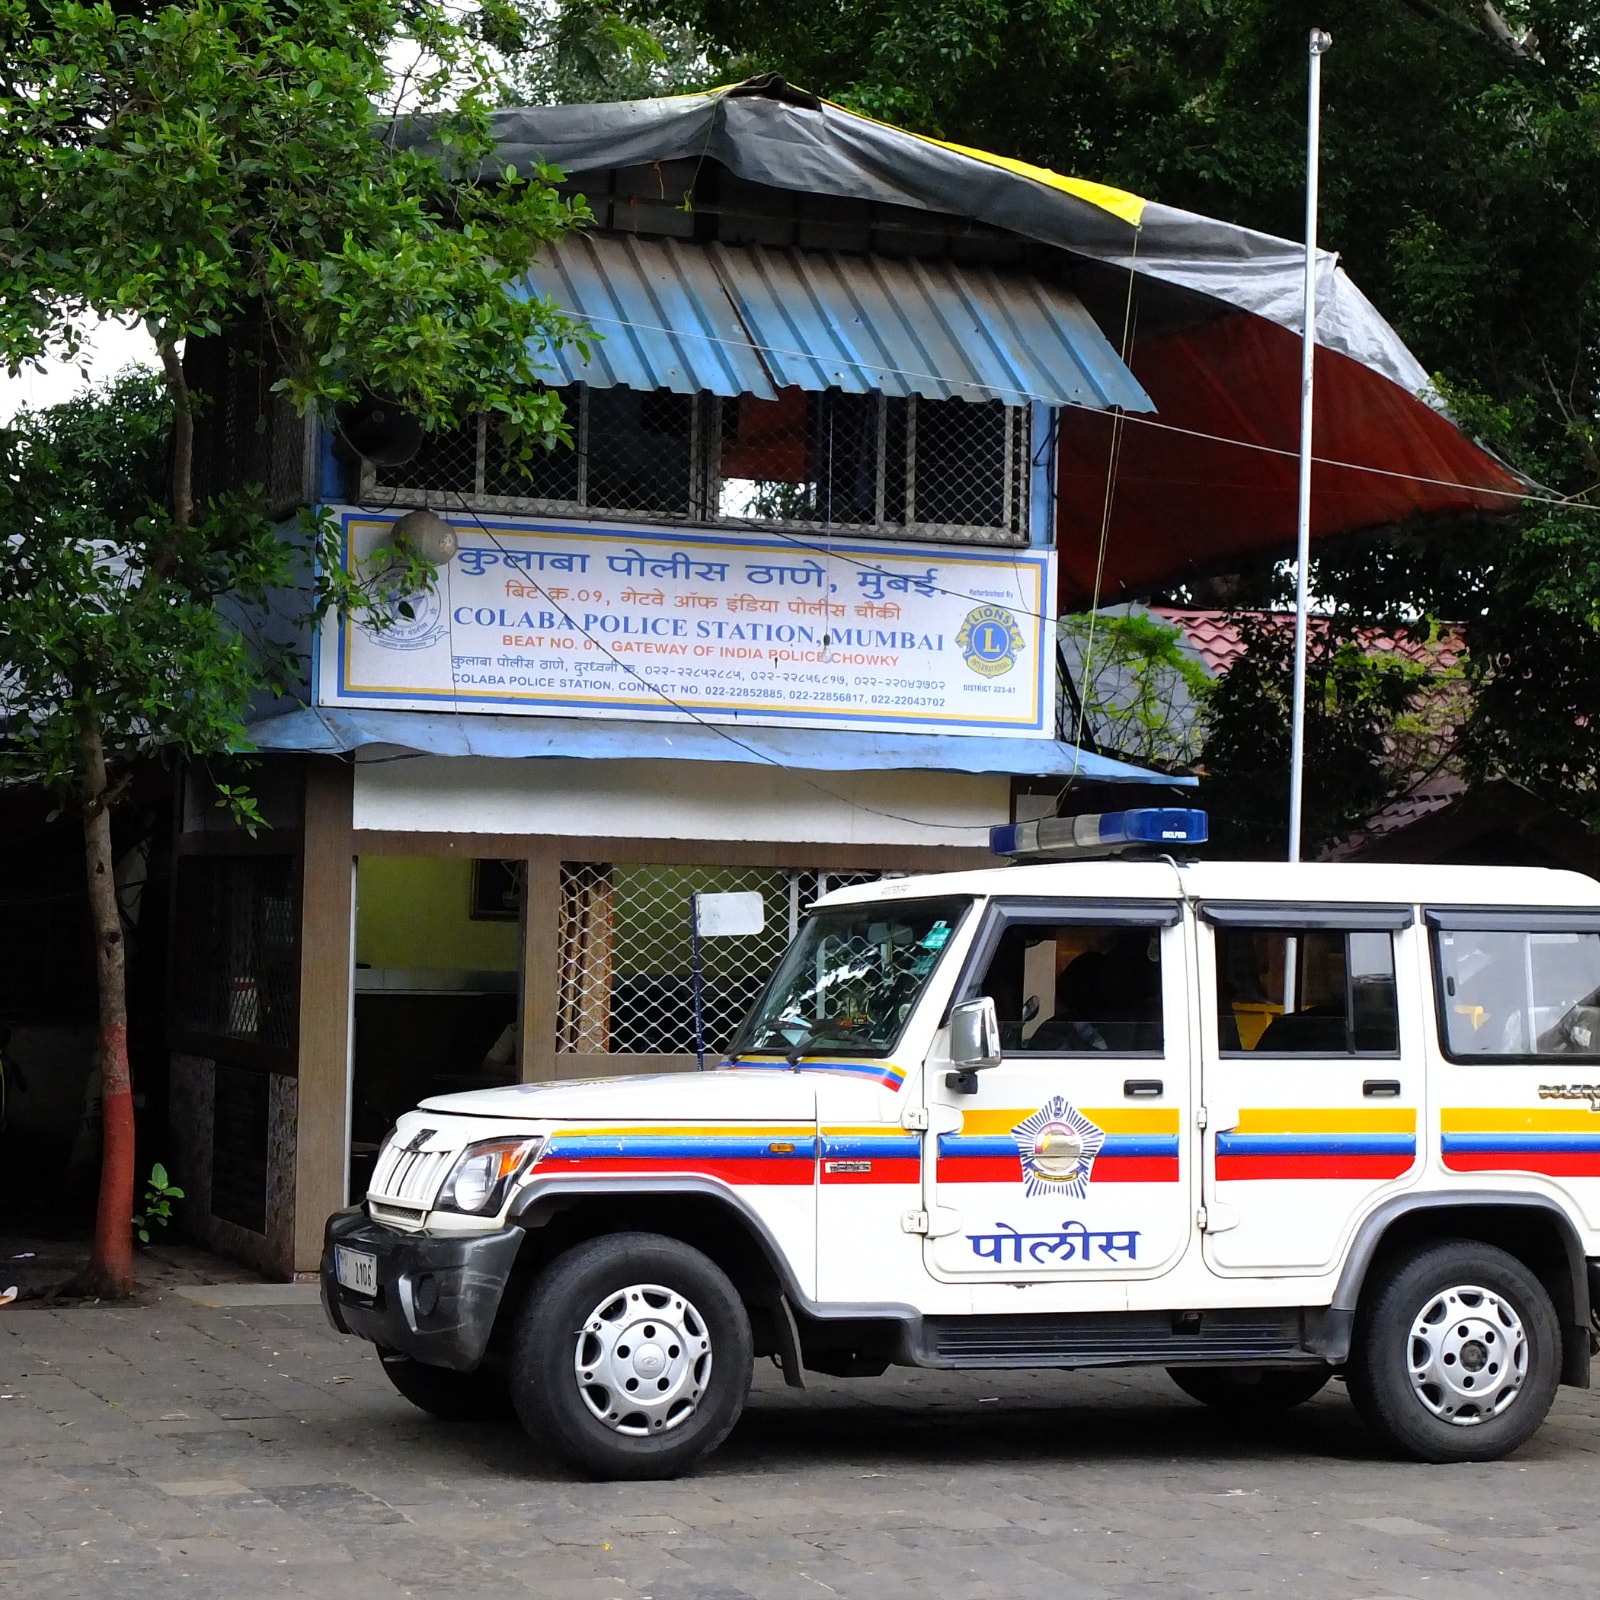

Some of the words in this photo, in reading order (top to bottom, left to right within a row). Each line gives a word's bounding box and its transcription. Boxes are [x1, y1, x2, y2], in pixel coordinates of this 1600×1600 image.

[457, 547, 591, 576] कुलाबा
[606, 548, 730, 582] पोलीस
[745, 559, 838, 593] ठाणे,
[857, 565, 948, 599] मुंबई.
[505, 579, 539, 599] बिट
[620, 586, 665, 606] गेटवे
[673, 592, 719, 609] ऑफ
[726, 593, 779, 613] इंडिया
[788, 596, 846, 617] पोलीस
[854, 601, 901, 620] चौकी
[454, 606, 575, 631] COLABA
[584, 613, 688, 637] POLICE
[696, 620, 821, 648] STATION,
[830, 627, 944, 651] MUMBAI
[971, 608, 1012, 626] LIONS
[502, 635, 545, 648] BEAT
[550, 637, 578, 650] NO.
[611, 640, 688, 655] GATEWAY
[693, 645, 715, 657] OF
[720, 647, 763, 660] INDIA
[768, 649, 826, 663] POLICE
[831, 652, 900, 667] CHOWKY
[983, 628, 1000, 653] L
[452, 655, 492, 669] कुलाबा
[497, 654, 534, 669] पोलीस
[540, 657, 569, 672] ठाणे,
[452, 673, 506, 685] COLABA
[509, 676, 555, 688] POLICE
[559, 678, 615, 692] STATION,
[618, 681, 677, 694] CONTACT
[680, 684, 701, 696] NO.
[871, 695, 945, 708] 022-22043702
[963, 684, 992, 693] DISTRICT
[965, 1220, 1142, 1264] पोलीस
